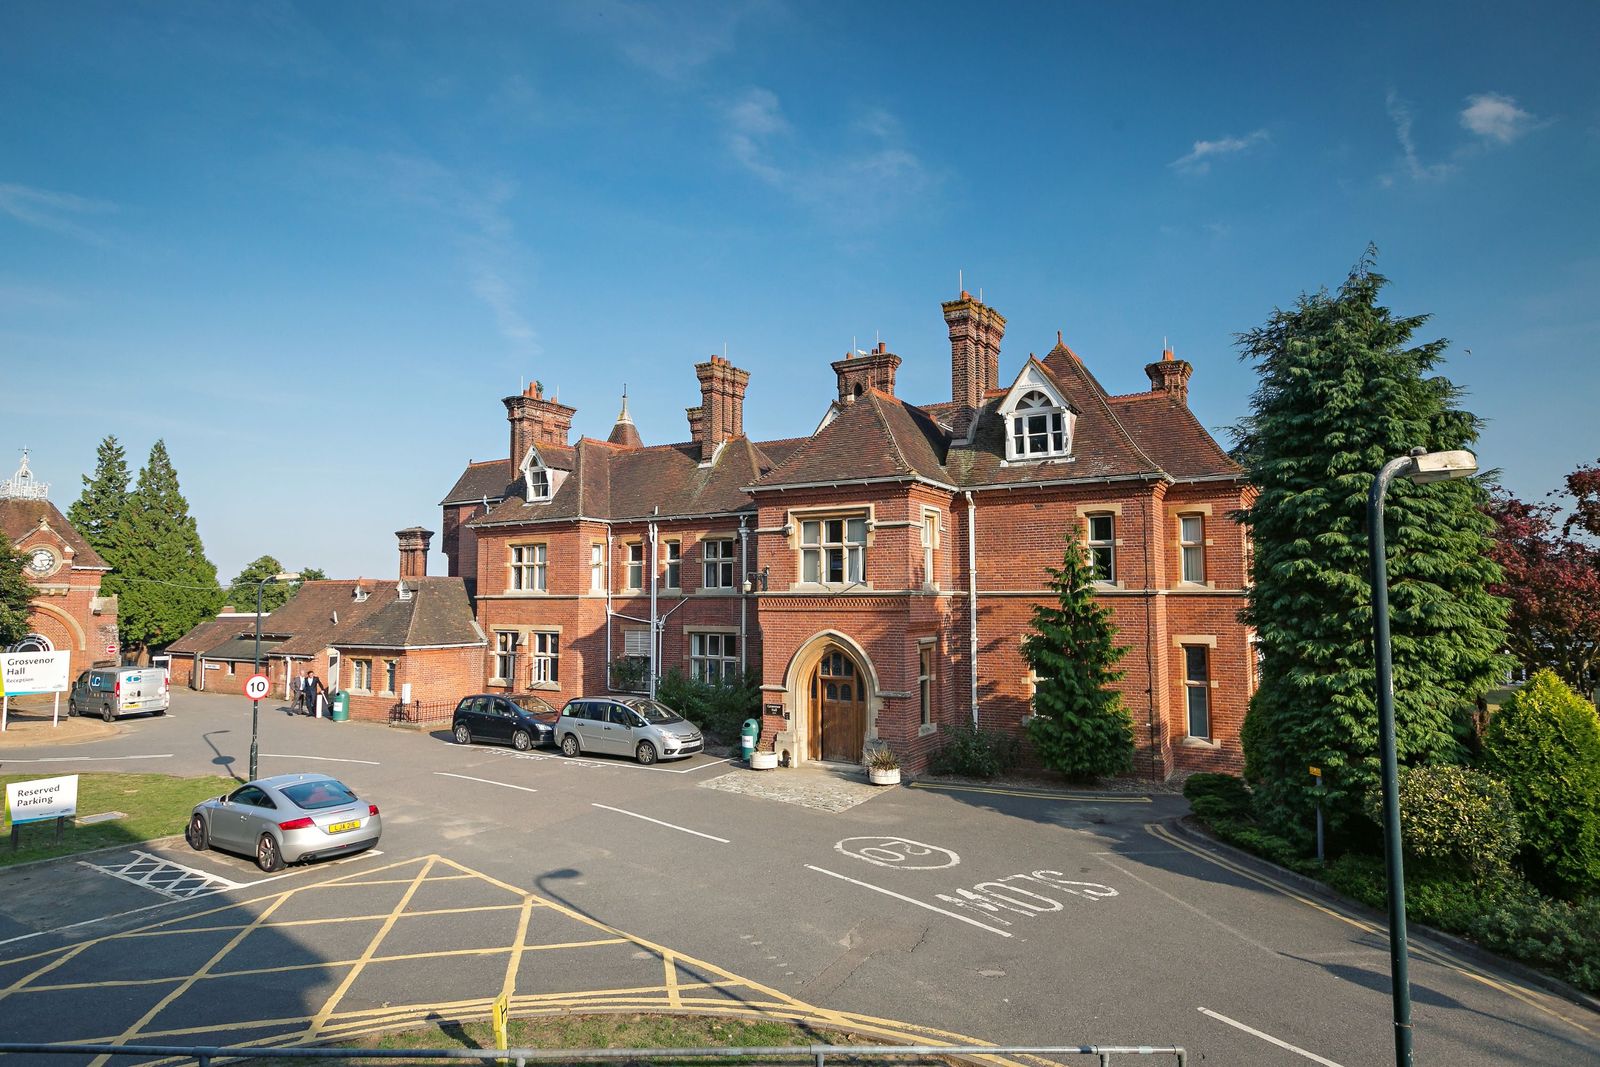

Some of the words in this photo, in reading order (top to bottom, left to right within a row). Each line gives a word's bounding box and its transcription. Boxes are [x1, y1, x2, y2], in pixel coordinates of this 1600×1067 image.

[7, 658, 55, 666] Grosvenor
[7, 667, 26, 675] Hall
[250, 681, 266, 693] 10
[17, 784, 61, 797] Reserved
[17, 796, 54, 807] Parking
[935, 869, 1119, 925] SLOW
